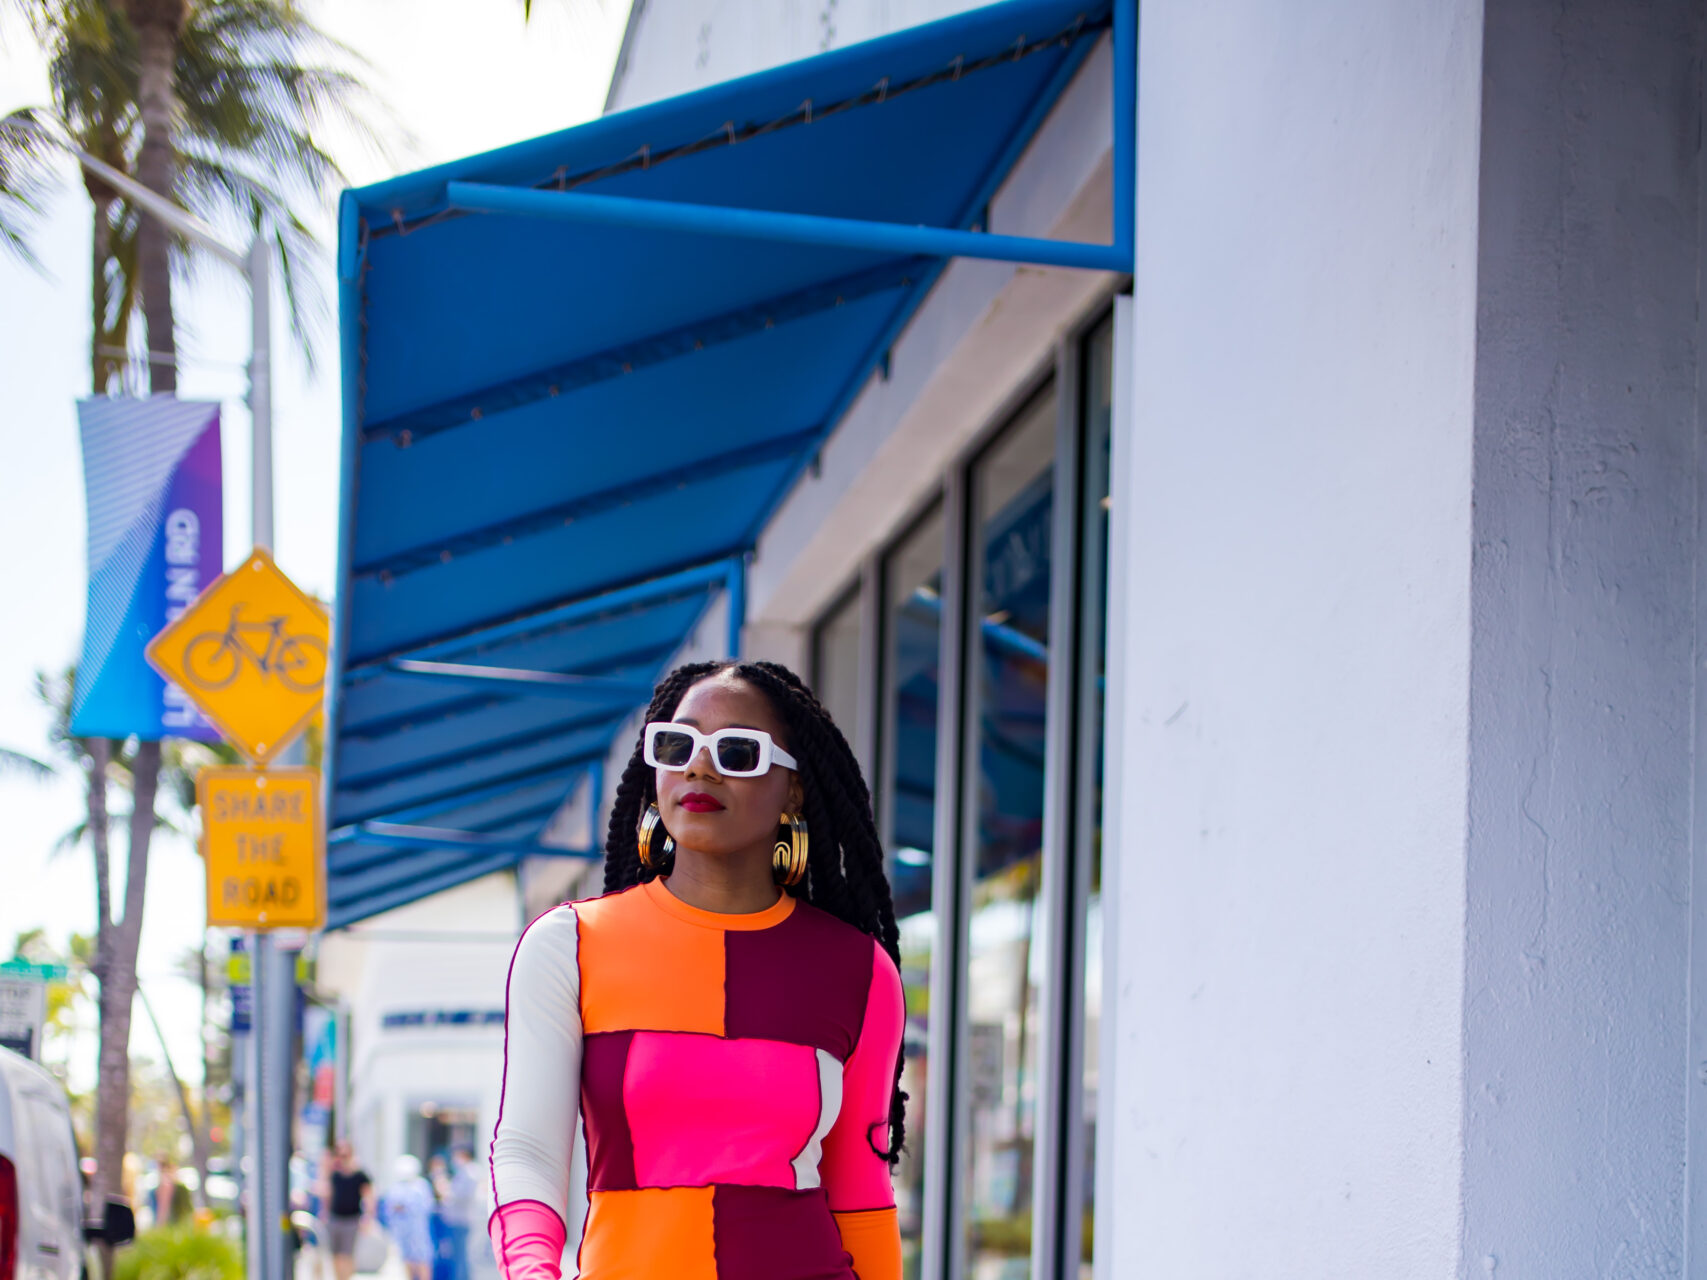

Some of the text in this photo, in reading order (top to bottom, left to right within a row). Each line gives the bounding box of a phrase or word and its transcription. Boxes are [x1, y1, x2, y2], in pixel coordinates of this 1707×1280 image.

[165, 508, 200, 565] RD
[212, 789, 307, 823] SHARE
[233, 832, 287, 866] THE
[222, 875, 301, 908] ROAD
